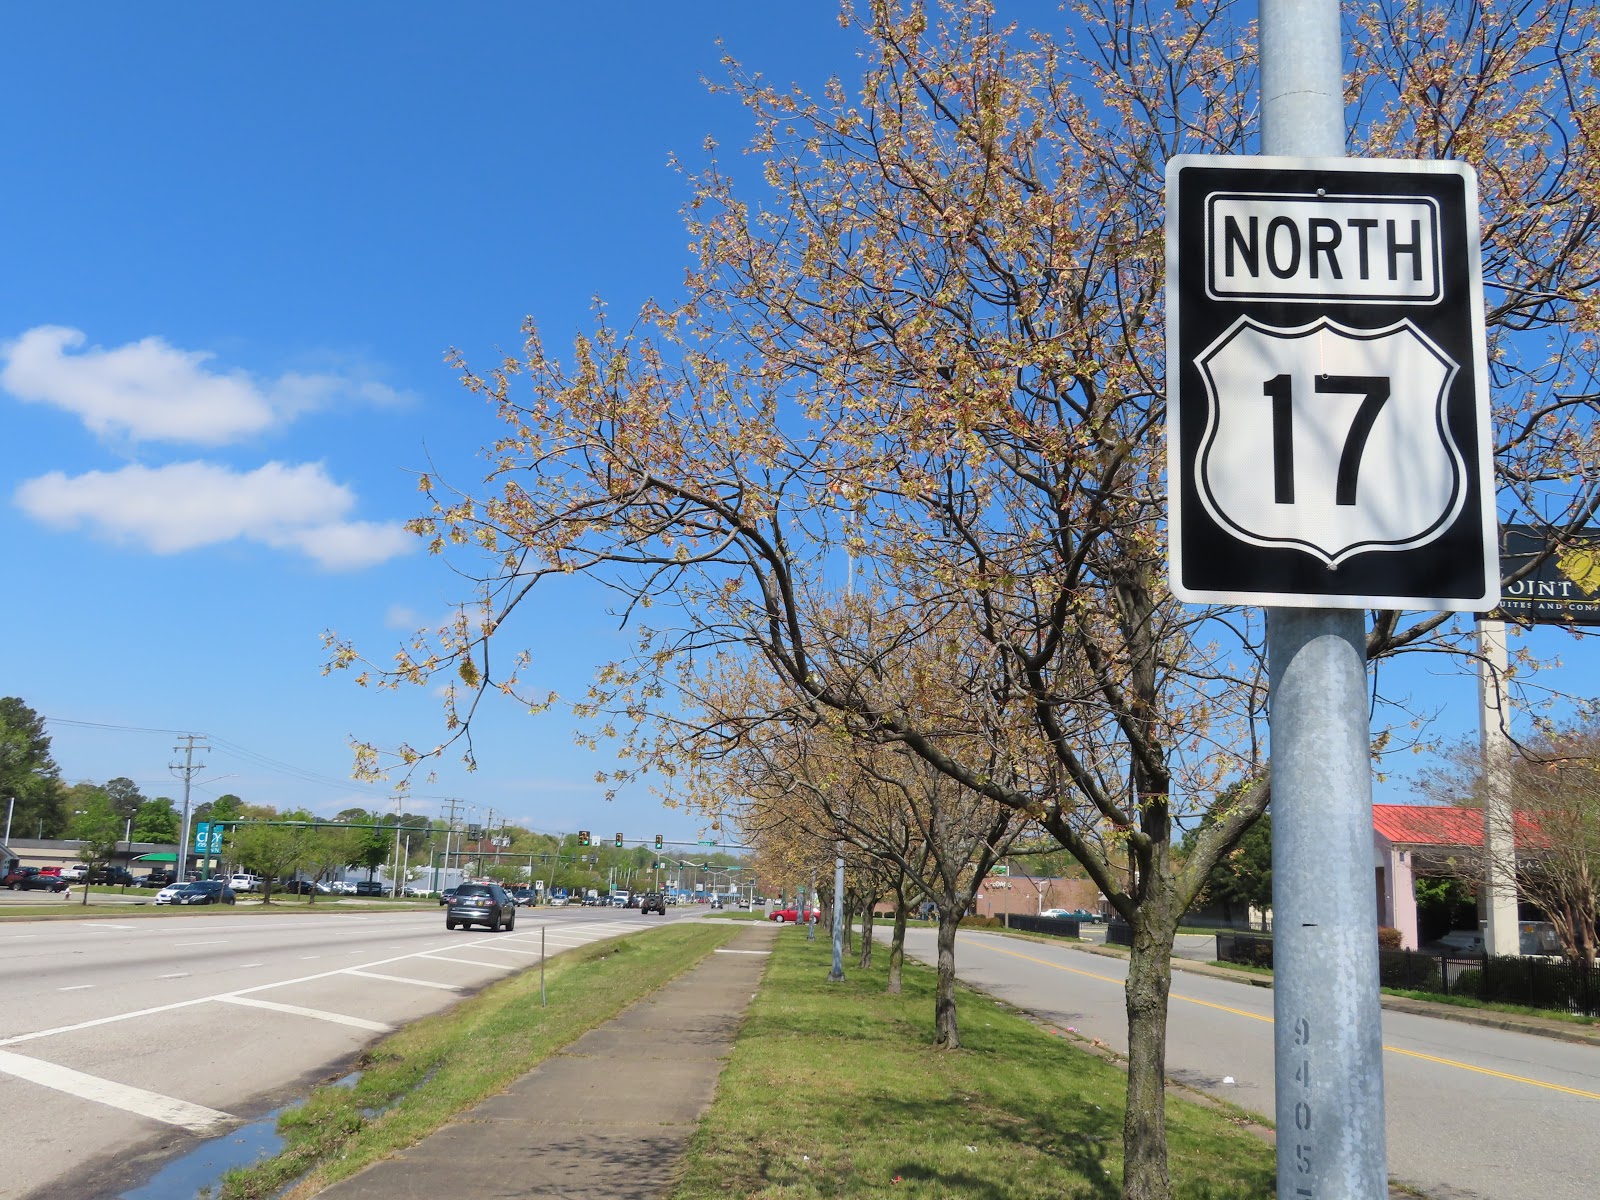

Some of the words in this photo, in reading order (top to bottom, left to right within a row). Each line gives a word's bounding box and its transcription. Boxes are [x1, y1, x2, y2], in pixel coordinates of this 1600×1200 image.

[1224, 215, 1422, 281] NORTH
[1262, 373, 1391, 506] 17
[1507, 580, 1571, 596] OINT
[1499, 600, 1532, 609] UITES
[196, 832, 222, 842] CIY
